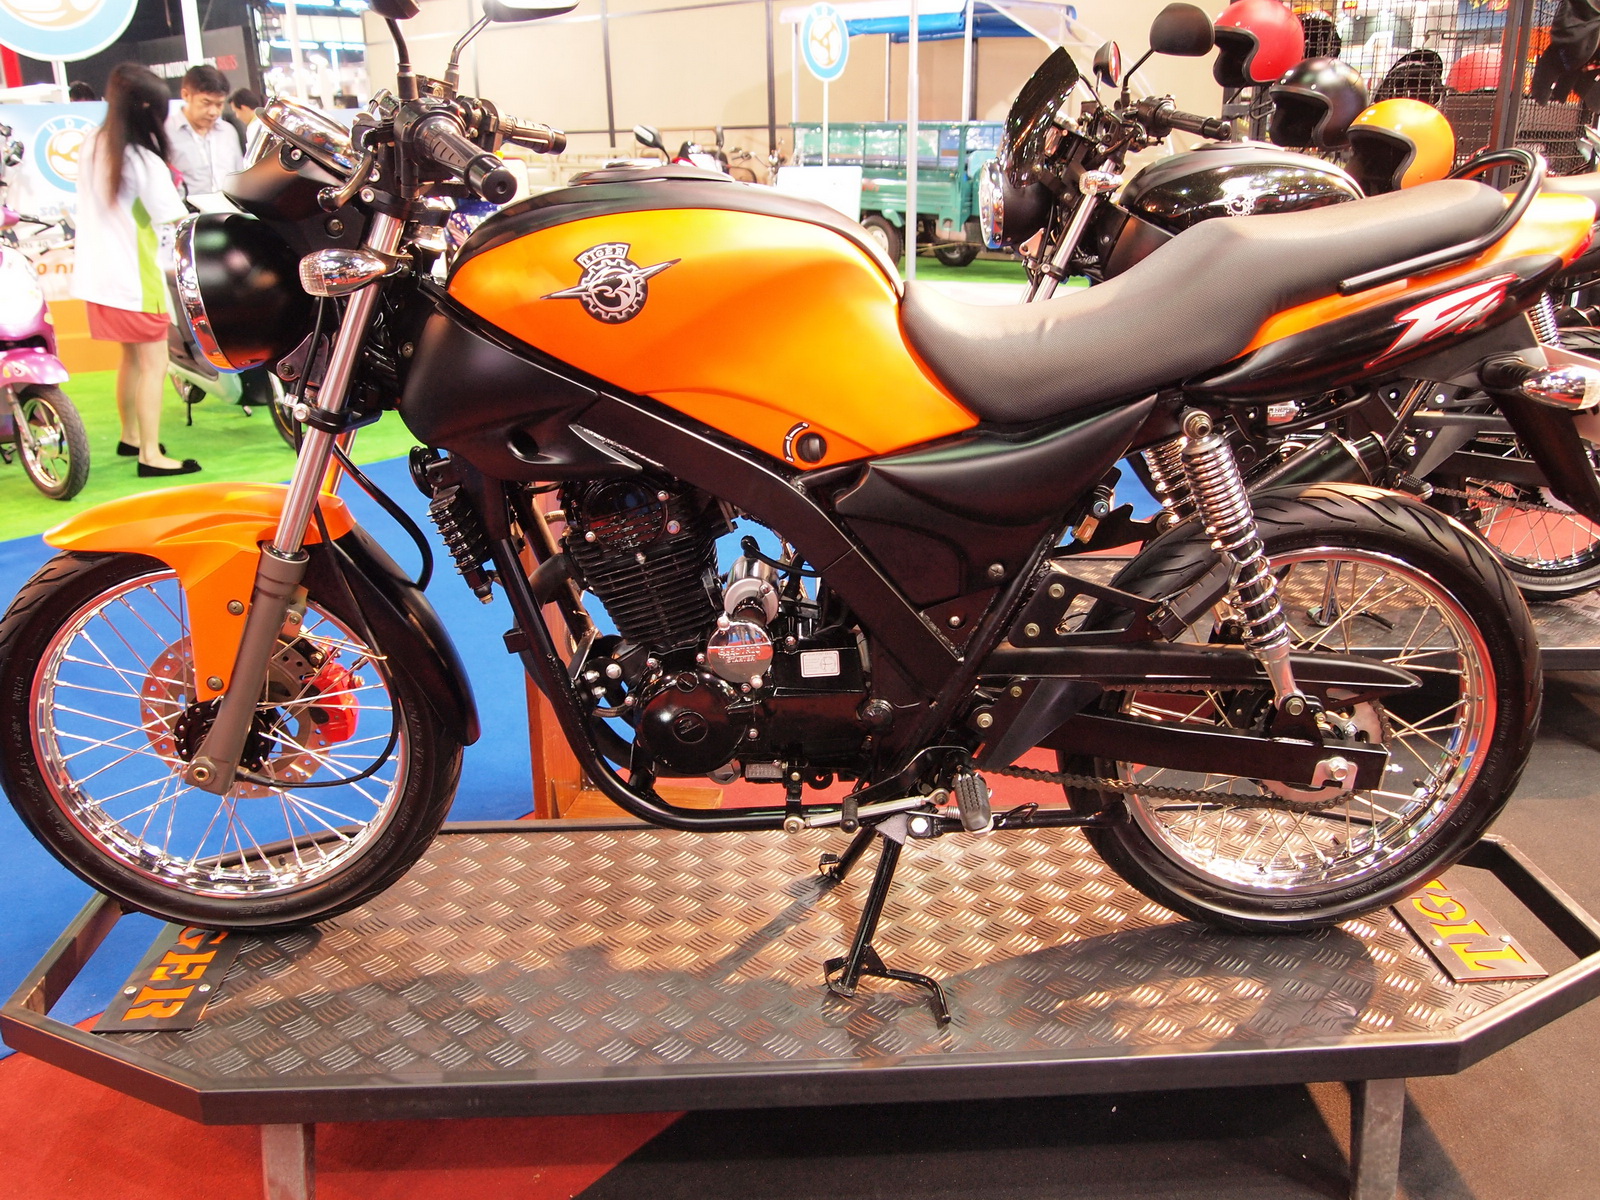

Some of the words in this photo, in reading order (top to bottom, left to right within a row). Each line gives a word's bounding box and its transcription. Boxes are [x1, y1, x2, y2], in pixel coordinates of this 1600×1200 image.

[579, 245, 626, 265] TIGER
[1410, 879, 1528, 971] TIG
[121, 926, 229, 1022] GER
